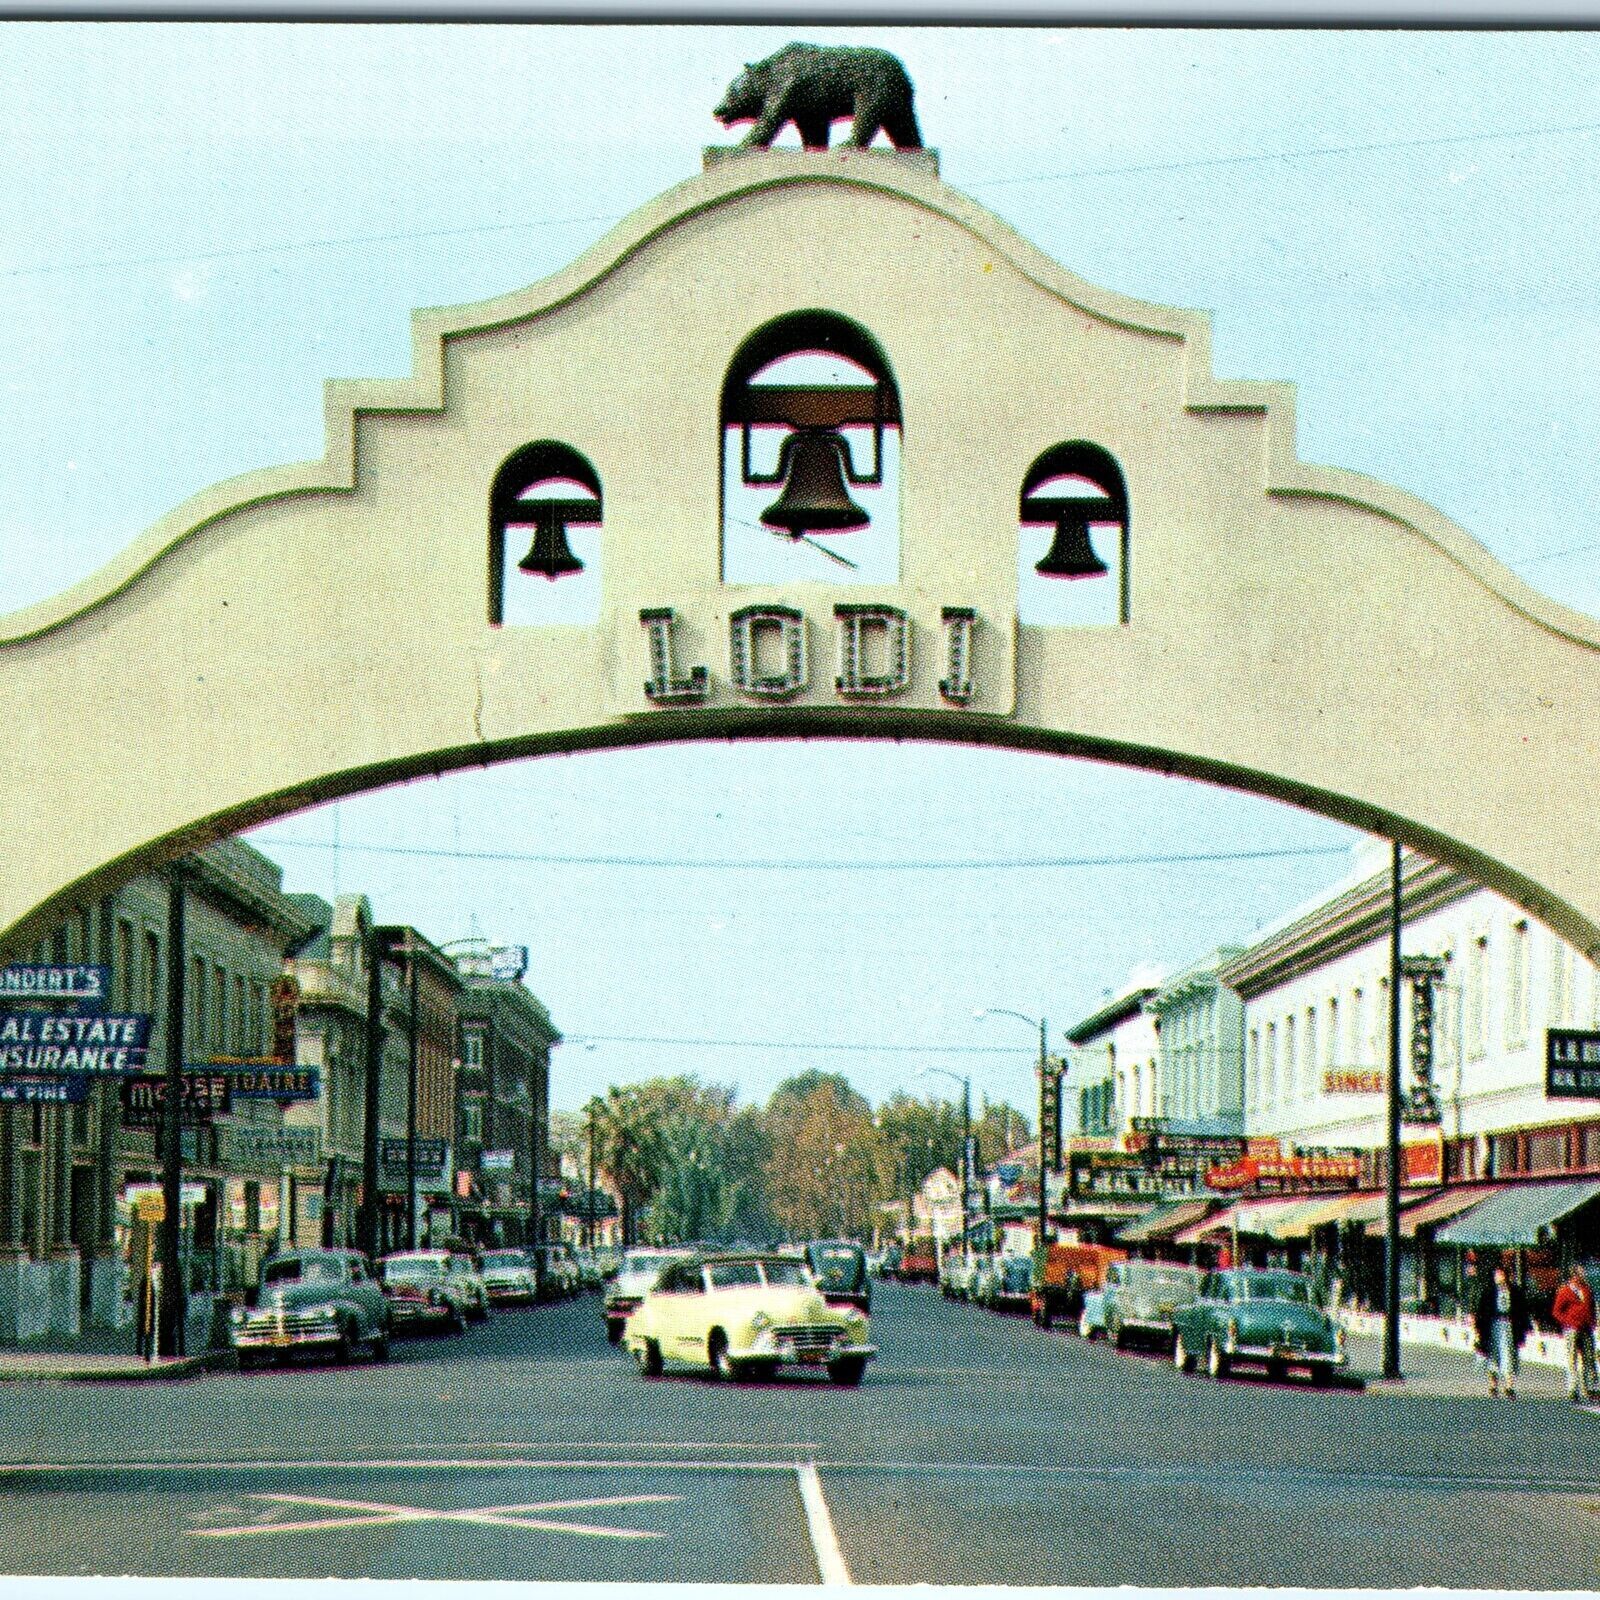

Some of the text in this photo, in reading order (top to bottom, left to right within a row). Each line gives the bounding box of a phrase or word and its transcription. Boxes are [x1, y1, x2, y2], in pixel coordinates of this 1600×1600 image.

[639, 603, 976, 705] LODI
[0, 967, 101, 989] NDERT'S
[40, 1017, 137, 1042] ESTATE
[232, 1072, 309, 1091] IDAIRE
